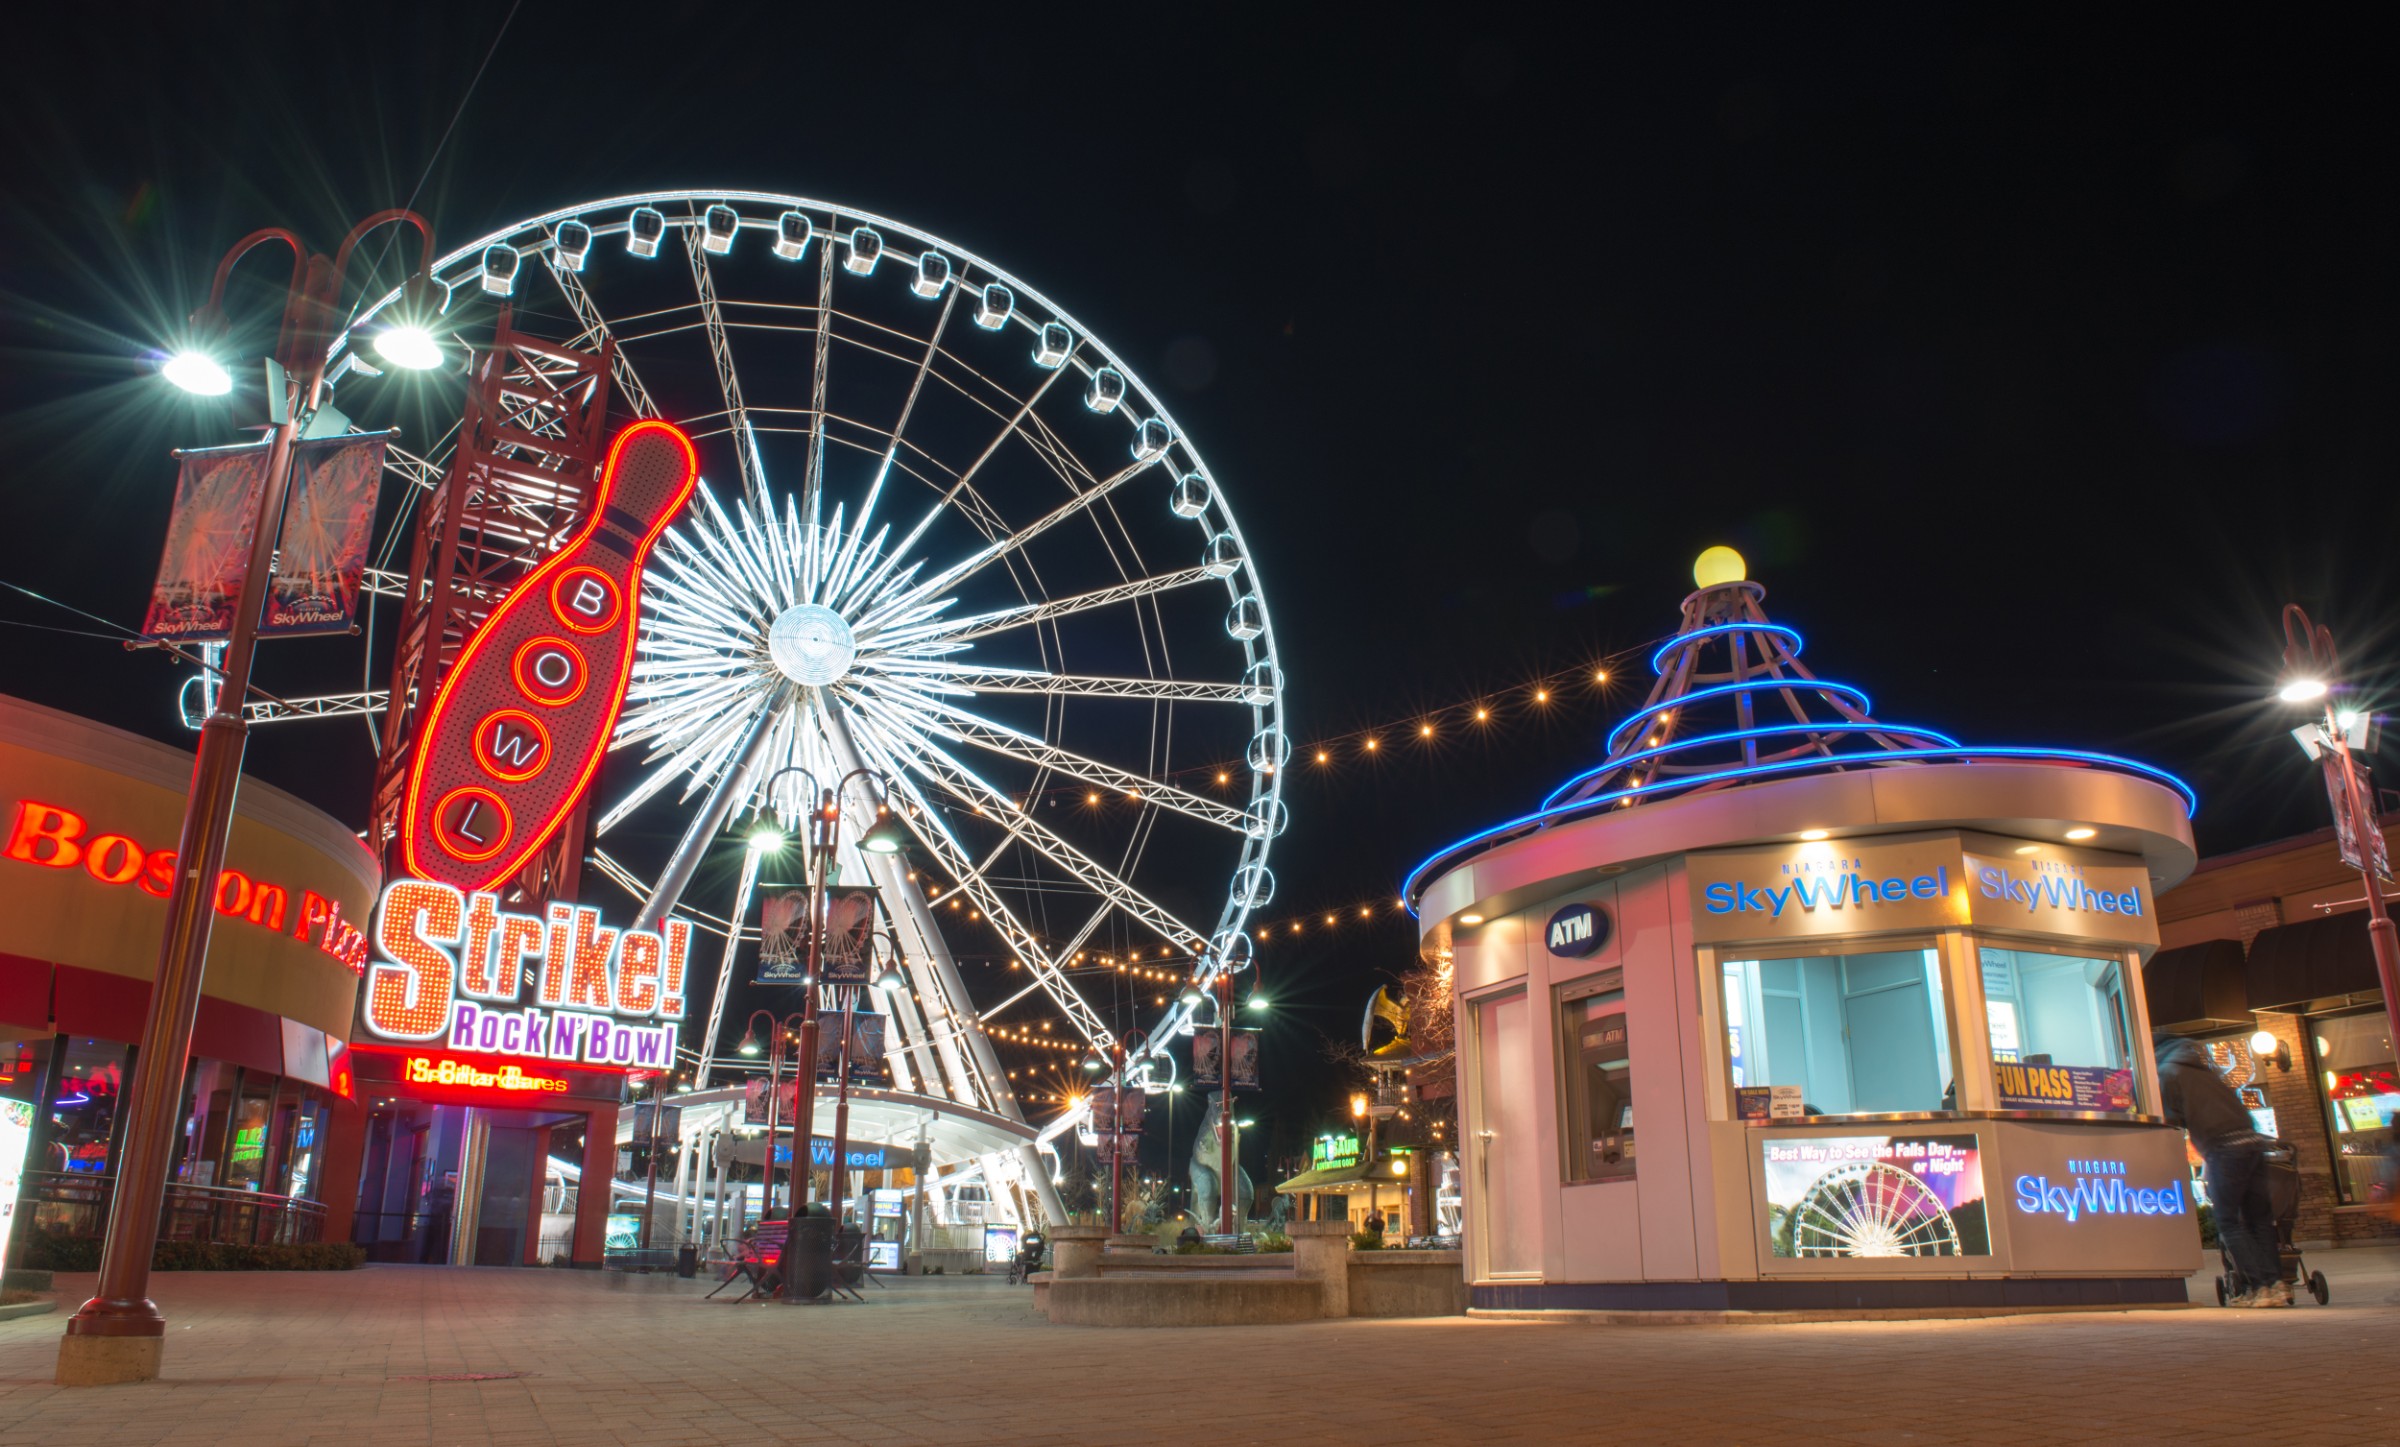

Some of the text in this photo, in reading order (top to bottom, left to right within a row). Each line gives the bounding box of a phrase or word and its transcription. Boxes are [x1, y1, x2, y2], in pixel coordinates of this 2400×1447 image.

[273, 610, 344, 626] SkyWheel
[154, 620, 222, 635] SkyWheel
[1, 800, 288, 932] Boson
[1782, 858, 1862, 875] NIAGARA
[2032, 860, 2085, 876] NIAGARA
[1705, 866, 1950, 918] SkyWheel
[1979, 866, 2143, 917] SkyWheel
[1550, 912, 1592, 948] ATM
[364, 878, 693, 1041] Strike!
[763, 971, 801, 980] SkyWheel
[828, 972, 865, 980] SkyWheel
[447, 999, 551, 1058] Rock
[1605, 1029, 1623, 1042] ATM
[2027, 1066, 2073, 1099] PASS
[1770, 1142, 1966, 1163] Best Way to See the Falls Day...
[1341, 1157, 1356, 1168] GOLF
[1913, 1160, 1964, 1175] or Night
[2068, 1160, 2126, 1175] NIAGARA
[2015, 1175, 2186, 1222] SkyWheel
